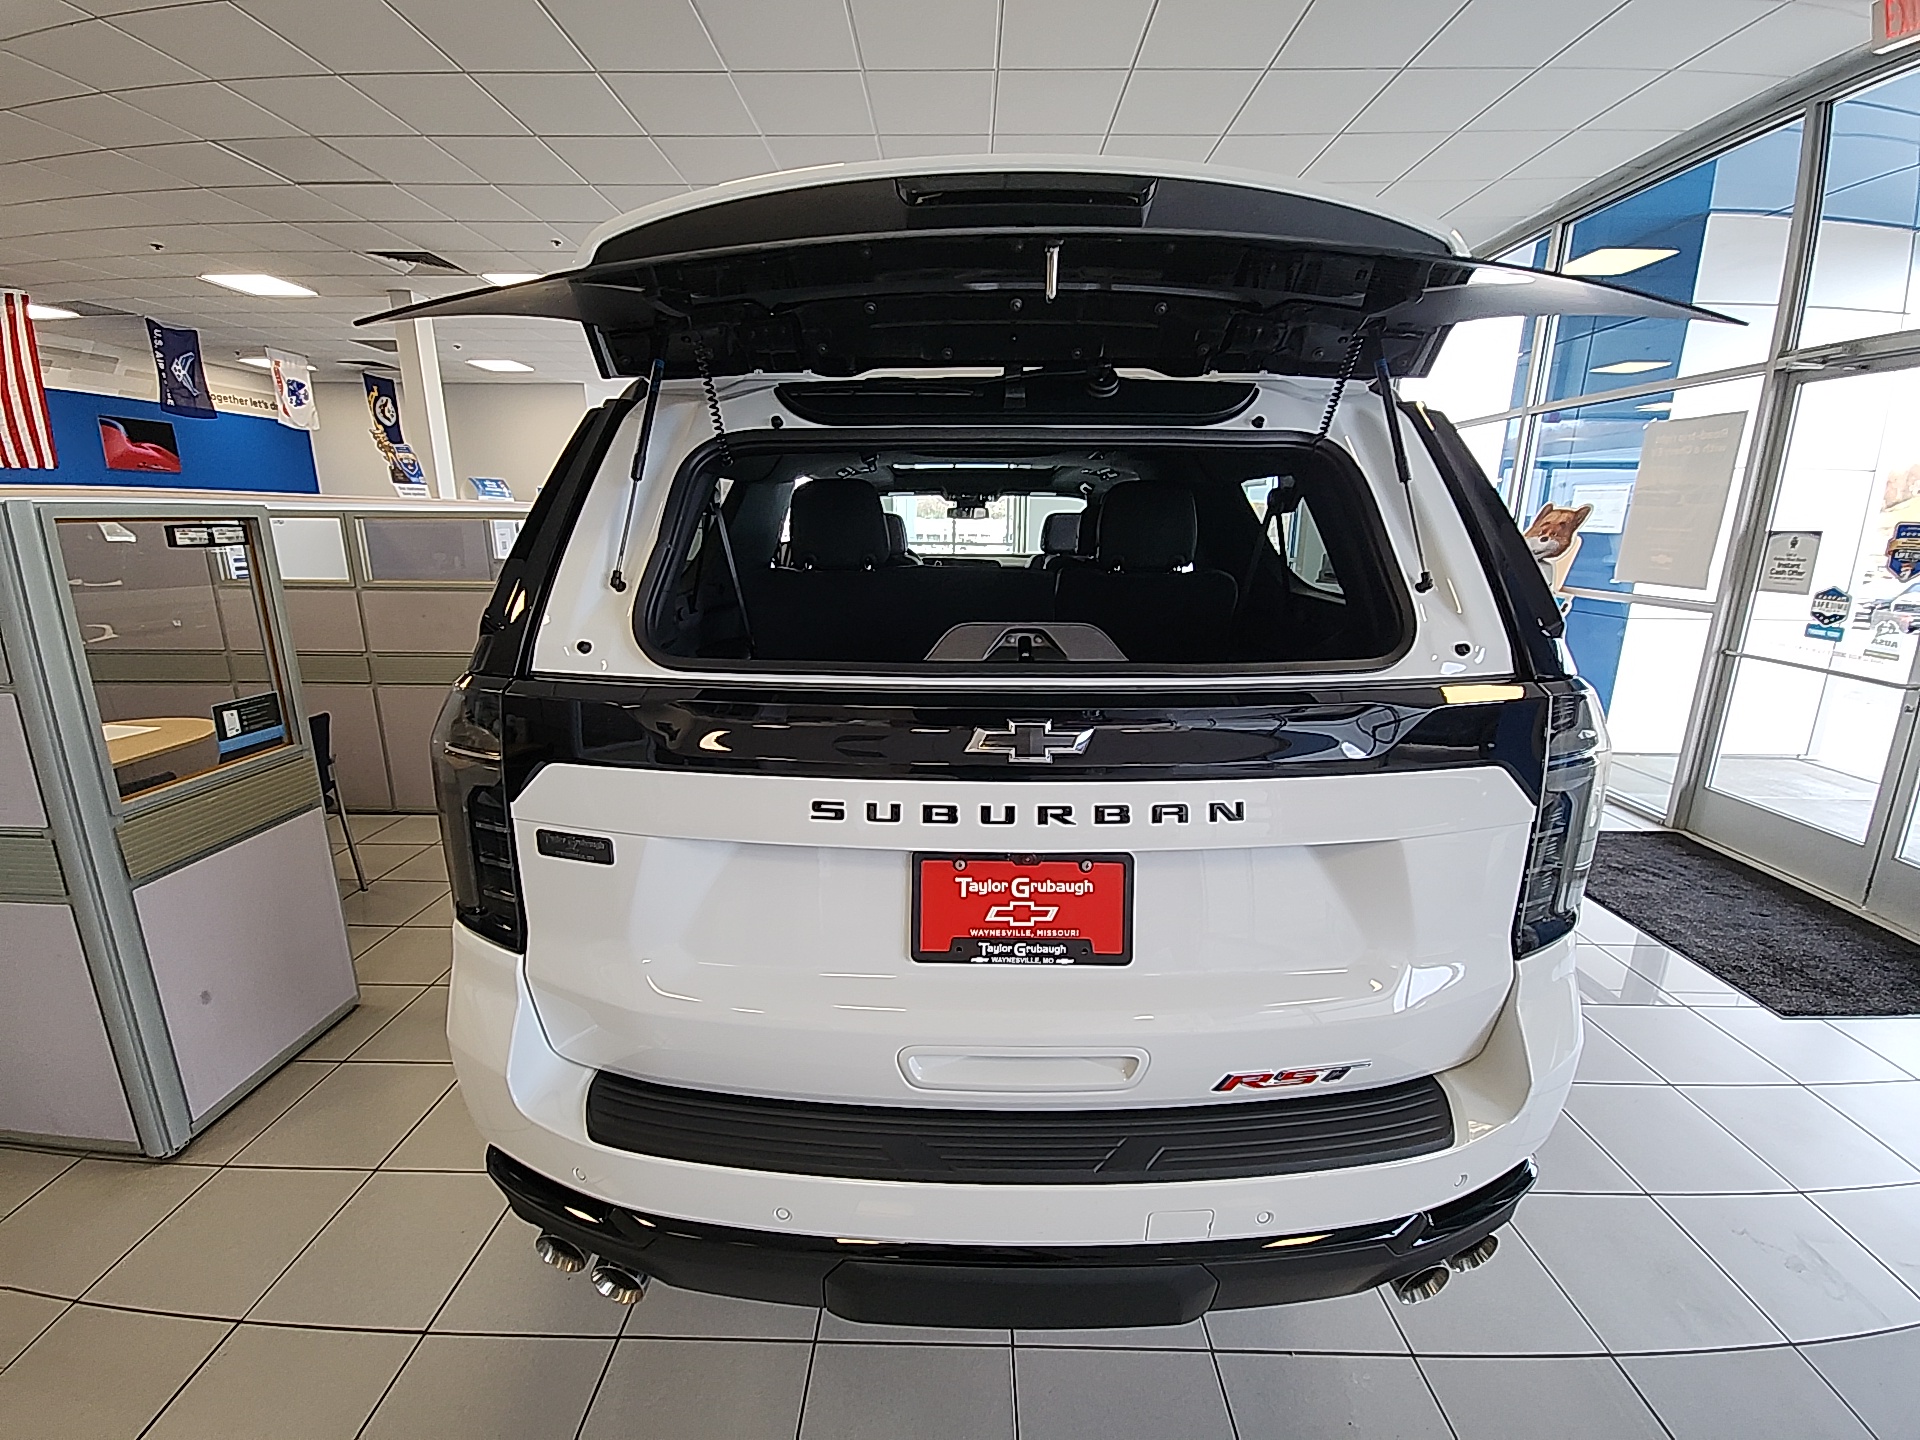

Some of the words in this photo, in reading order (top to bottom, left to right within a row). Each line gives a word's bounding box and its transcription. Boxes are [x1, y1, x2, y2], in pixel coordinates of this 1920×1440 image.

[210, 393, 248, 405] ogether
[249, 397, 269, 410] let's
[810, 800, 1246, 826] SUBURBAN
[954, 877, 1009, 898] Taylor
[1011, 877, 1094, 898] Grubaugh
[969, 928, 1035, 938] WAYNESVILLE,
[1036, 929, 1079, 937] MISSOURI
[977, 942, 1013, 957] Taylor
[1013, 942, 1067, 957] Grubaugh
[990, 956, 1042, 965] WAYNESVILLE,
[1211, 1060, 1372, 1092] RST
